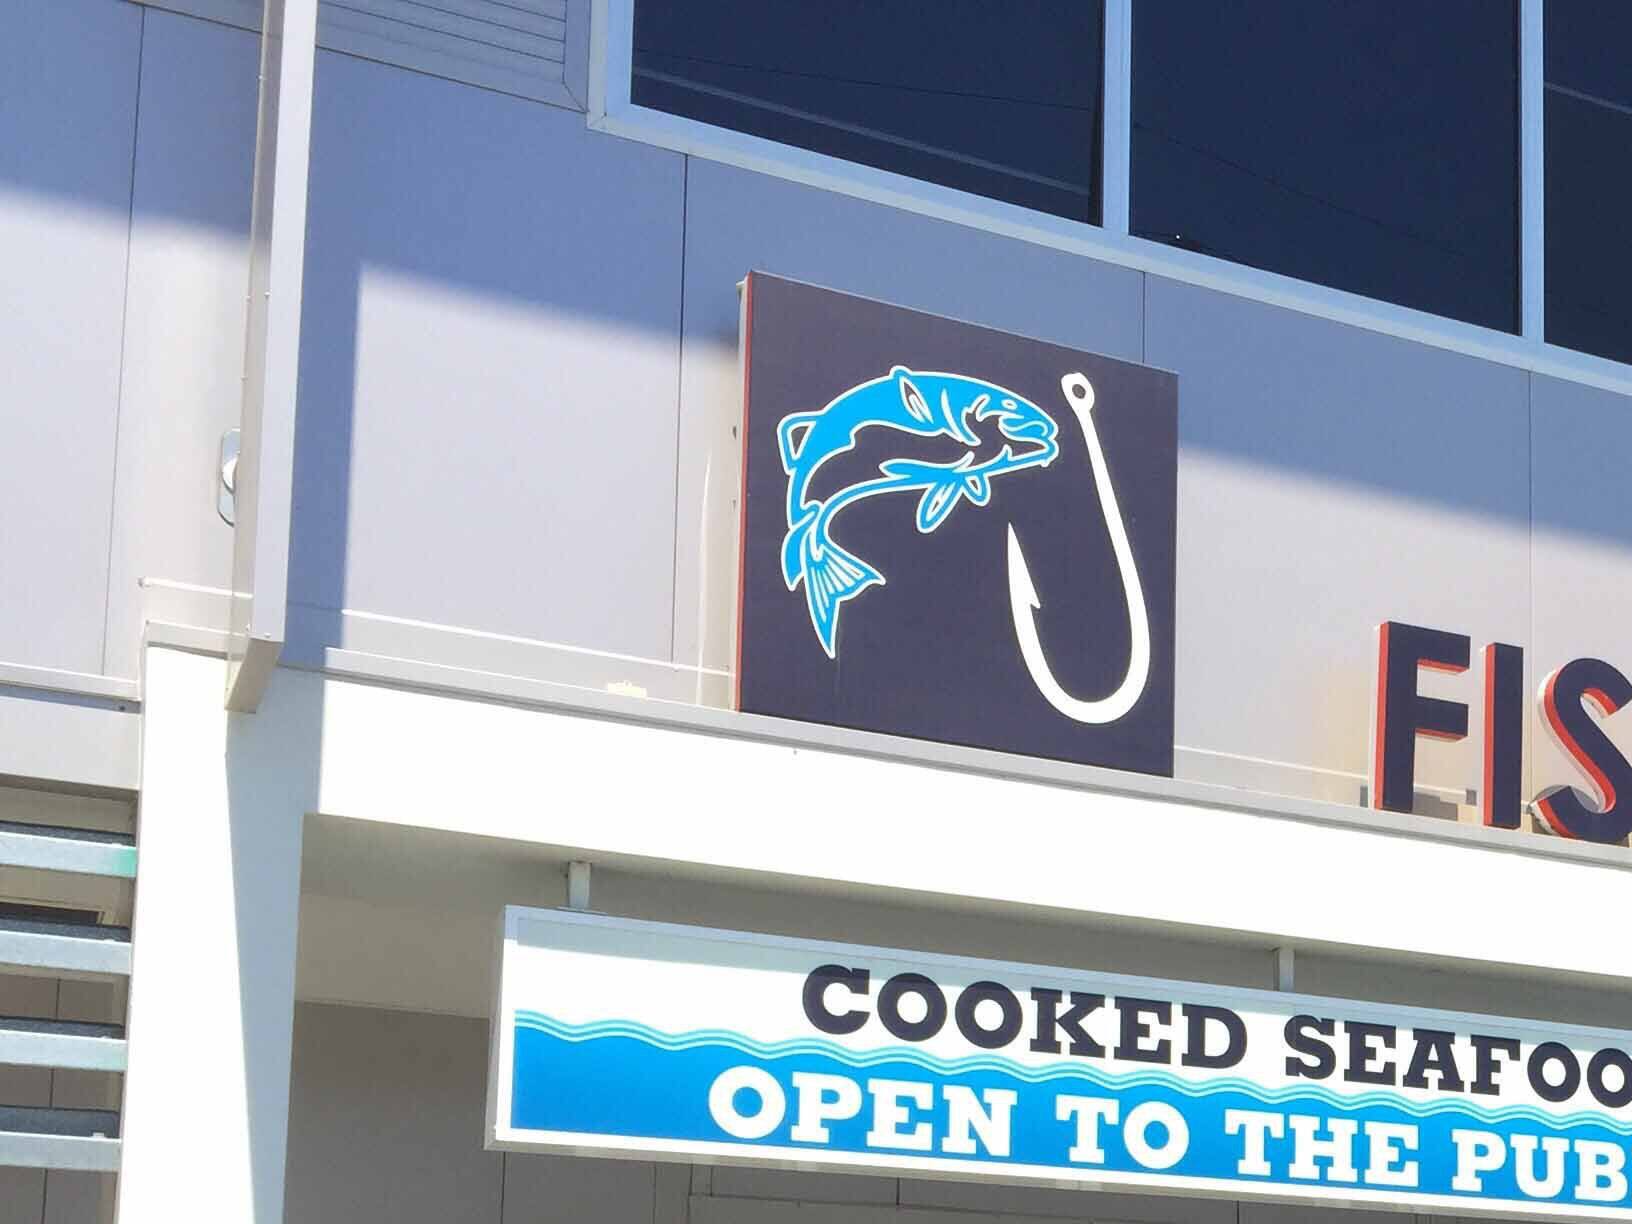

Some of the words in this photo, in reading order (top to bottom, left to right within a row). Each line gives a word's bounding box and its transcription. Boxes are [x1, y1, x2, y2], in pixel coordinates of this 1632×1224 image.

[802, 963, 1248, 1070] COOKED
[708, 1065, 1018, 1157] OPEN
[1056, 1092, 1190, 1170] TO
[1224, 1108, 1420, 1188] THE
